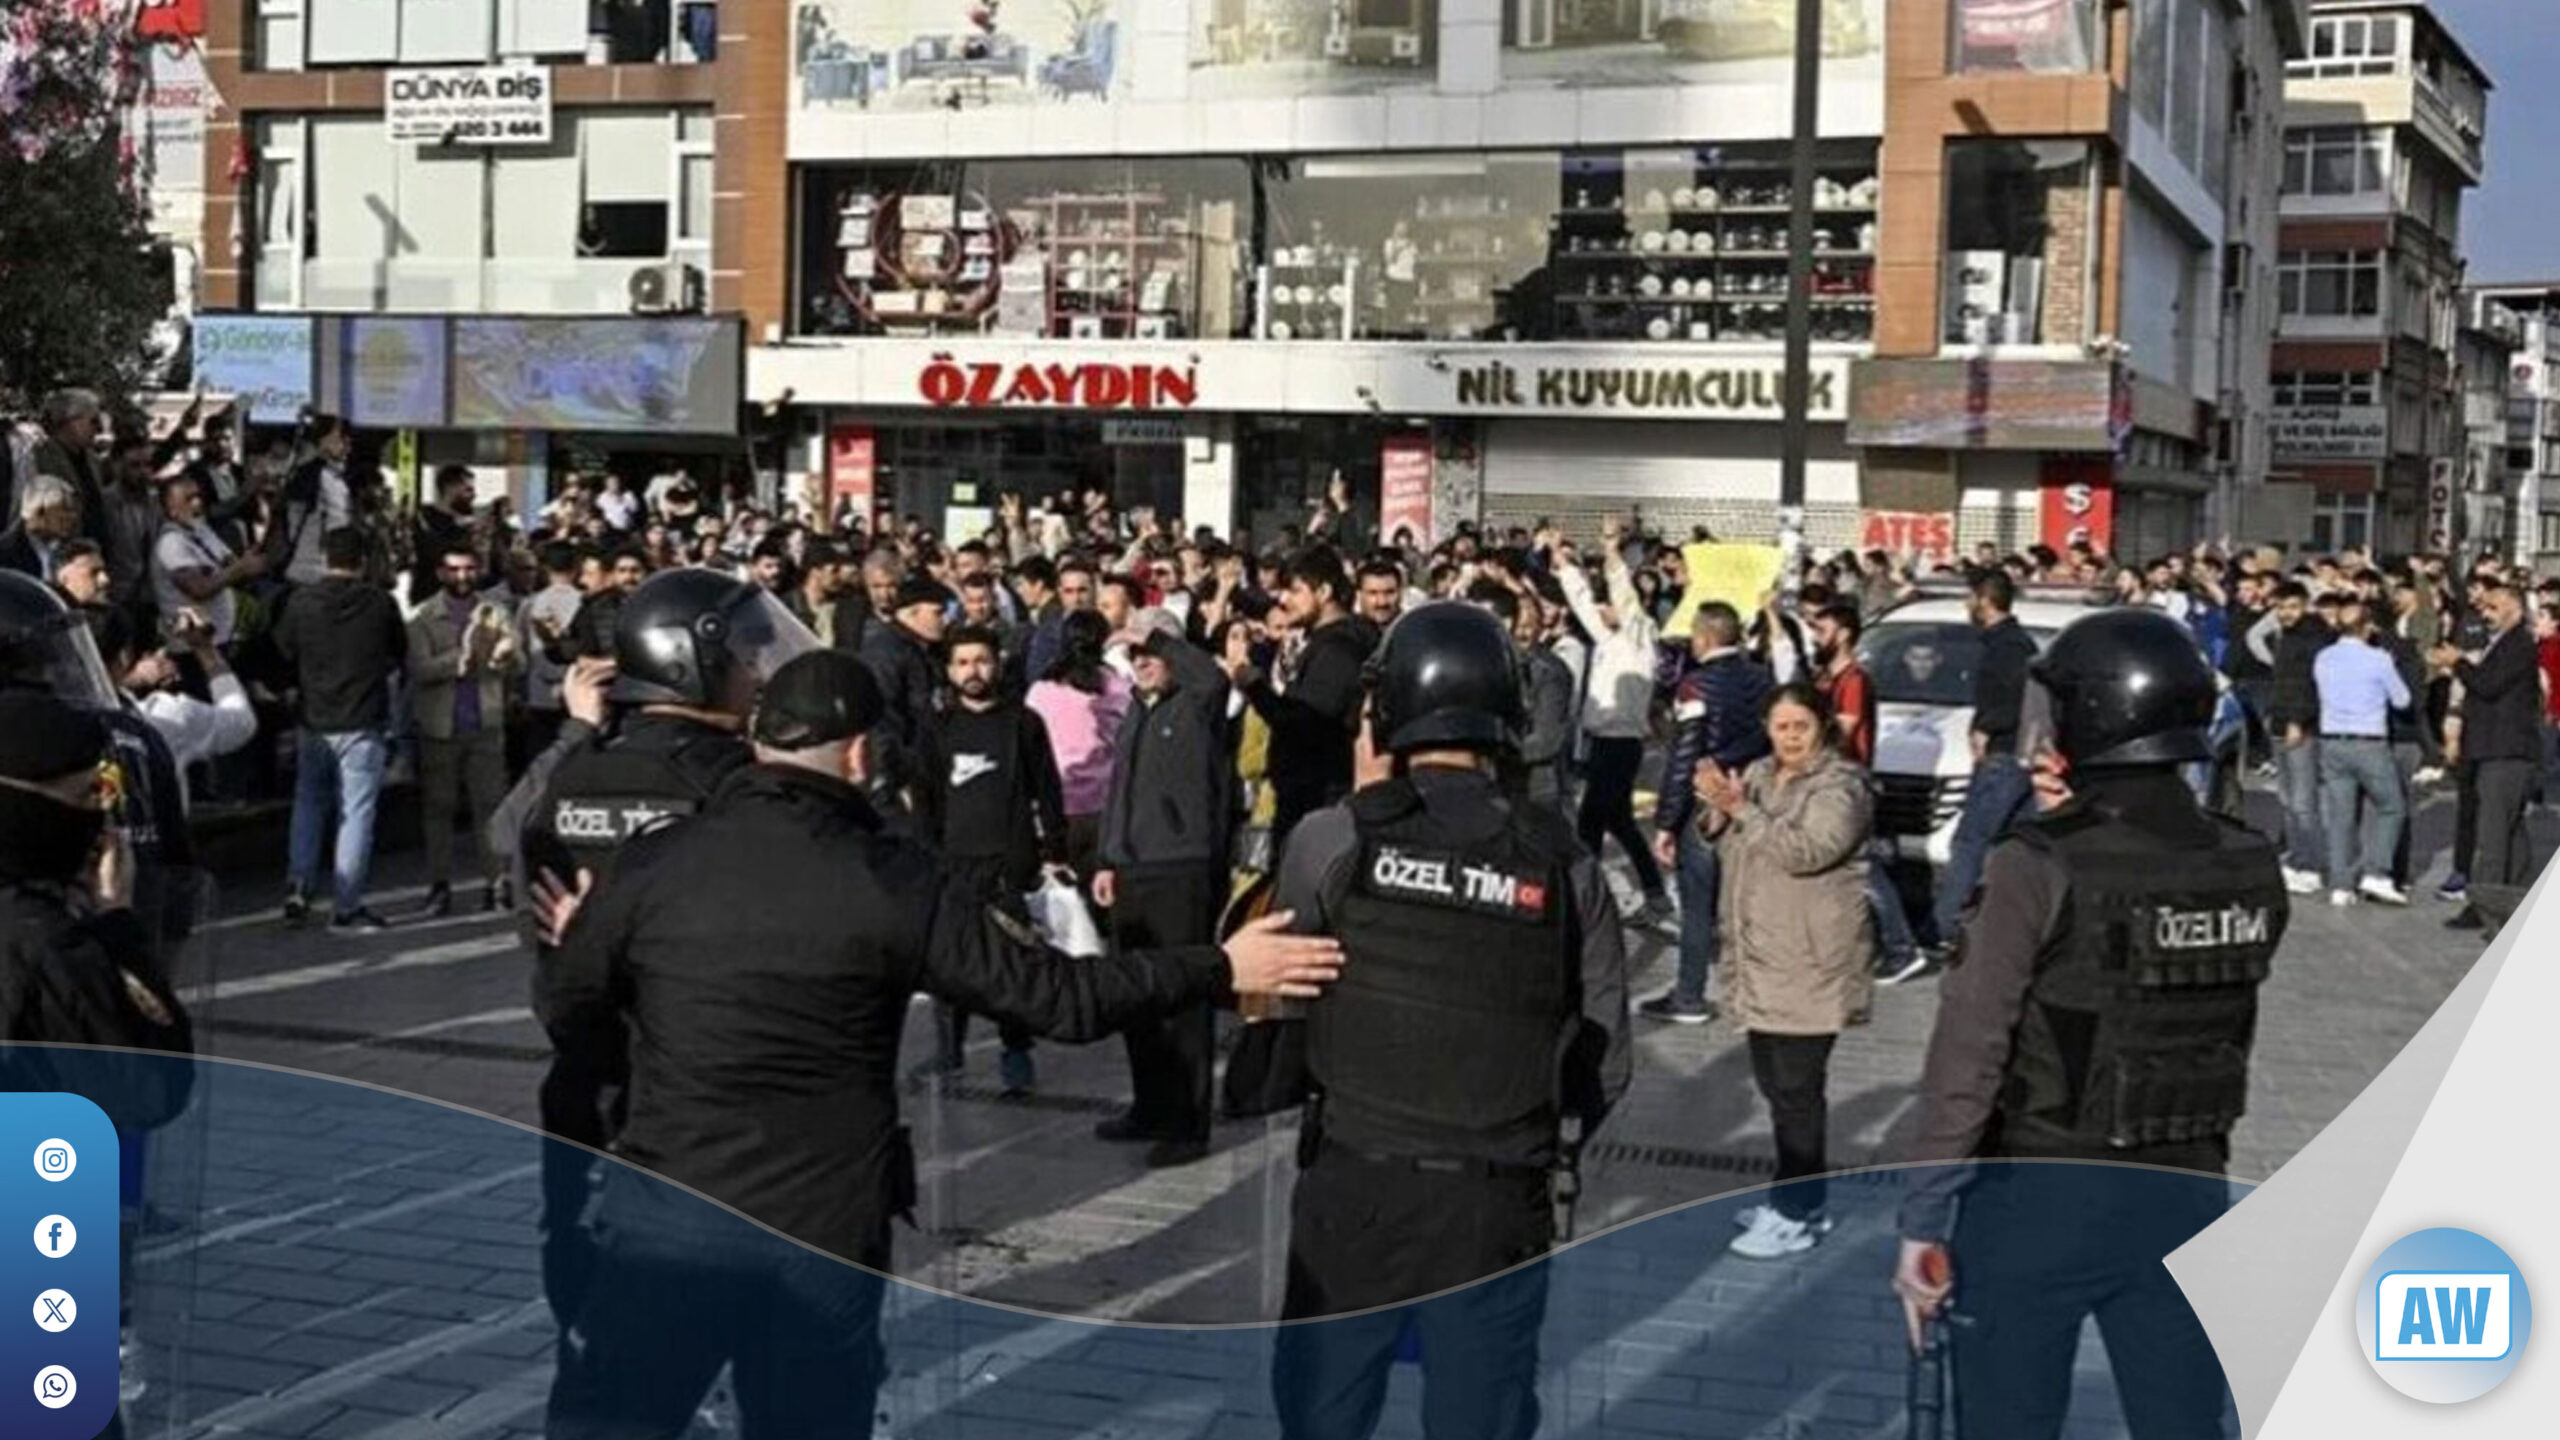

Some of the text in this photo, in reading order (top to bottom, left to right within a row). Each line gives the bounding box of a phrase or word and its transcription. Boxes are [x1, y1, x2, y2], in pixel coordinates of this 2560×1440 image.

[392, 71, 543, 102] DÜNYA DİŞ
[918, 351, 1198, 407] ÖZAYDIN
[1457, 360, 1524, 405] NİL
[556, 800, 617, 837] ÖZEL
[1373, 848, 1518, 907] ÖZEL TİM
